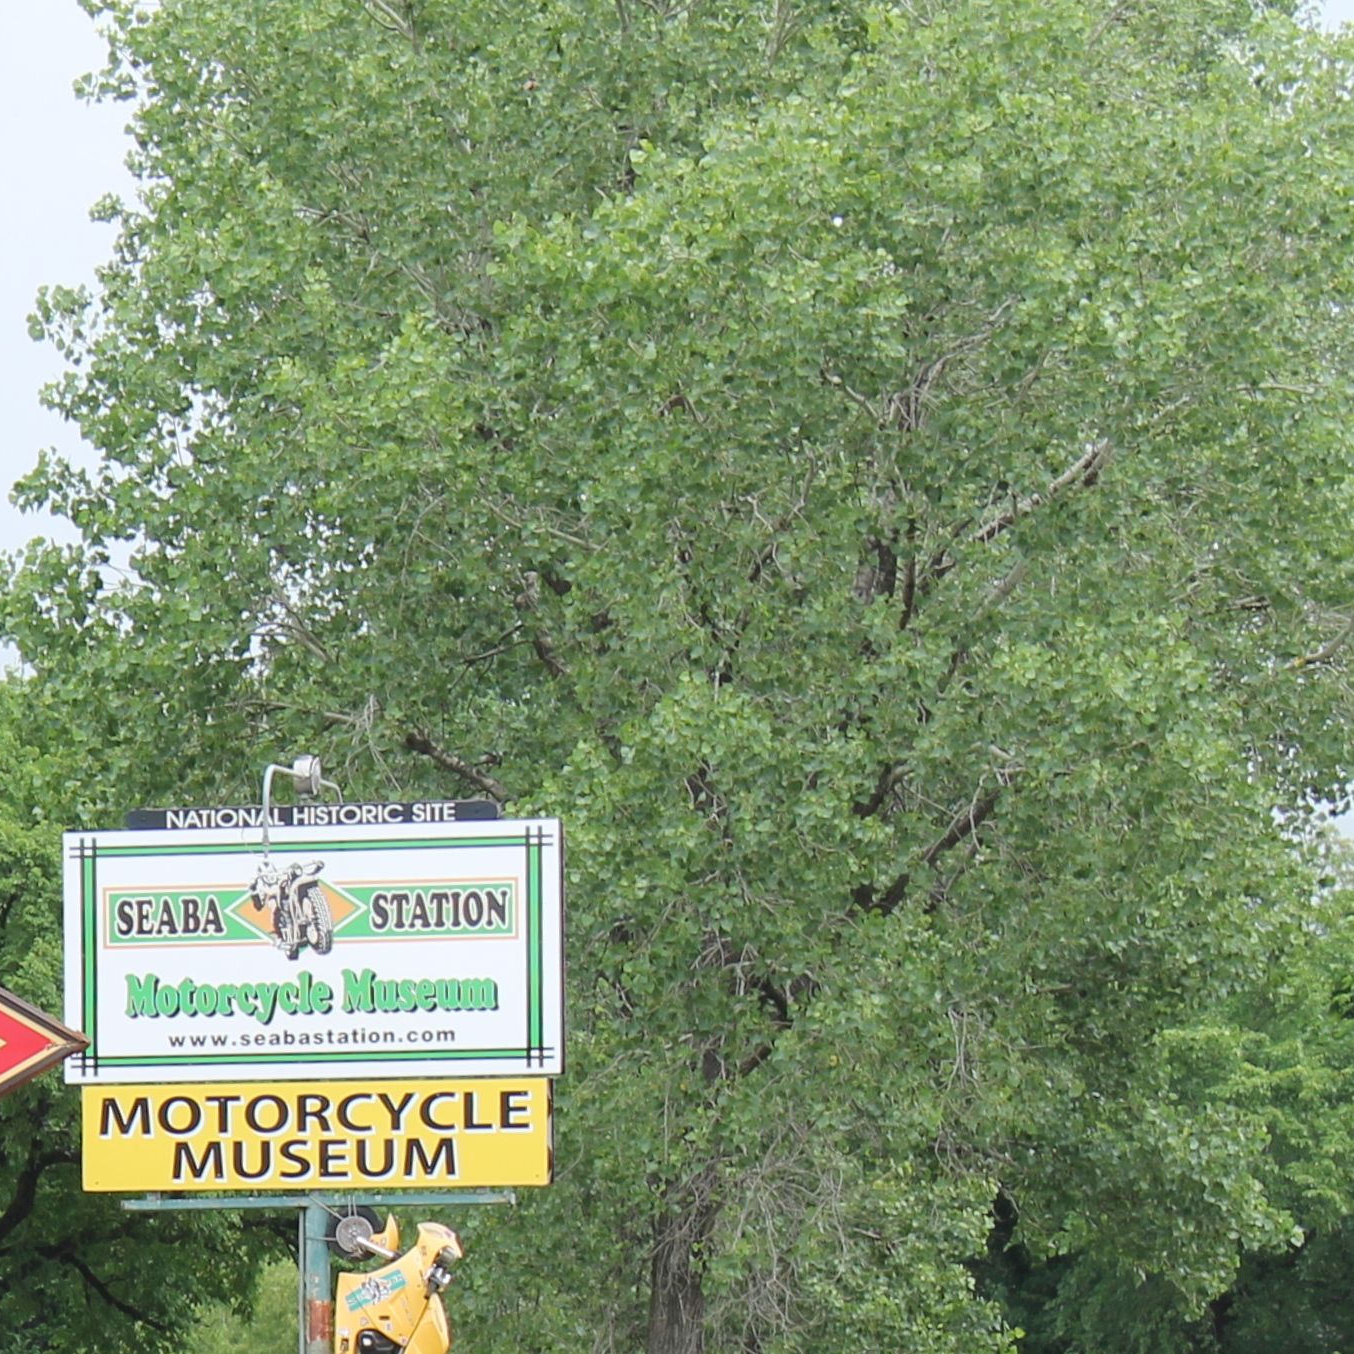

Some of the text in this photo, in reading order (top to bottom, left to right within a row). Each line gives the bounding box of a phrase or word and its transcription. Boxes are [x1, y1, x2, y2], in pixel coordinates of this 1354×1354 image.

[166, 802, 456, 829] NATIONAL HISTORIC SITE
[116, 889, 509, 936] SEABA STATION
[125, 969, 499, 1025] Motorcycle Museum
[168, 1028, 456, 1047] www.seabastation.com
[99, 1091, 531, 1136] MOTORCYCLE
[172, 1137, 457, 1181] MUSEUM
